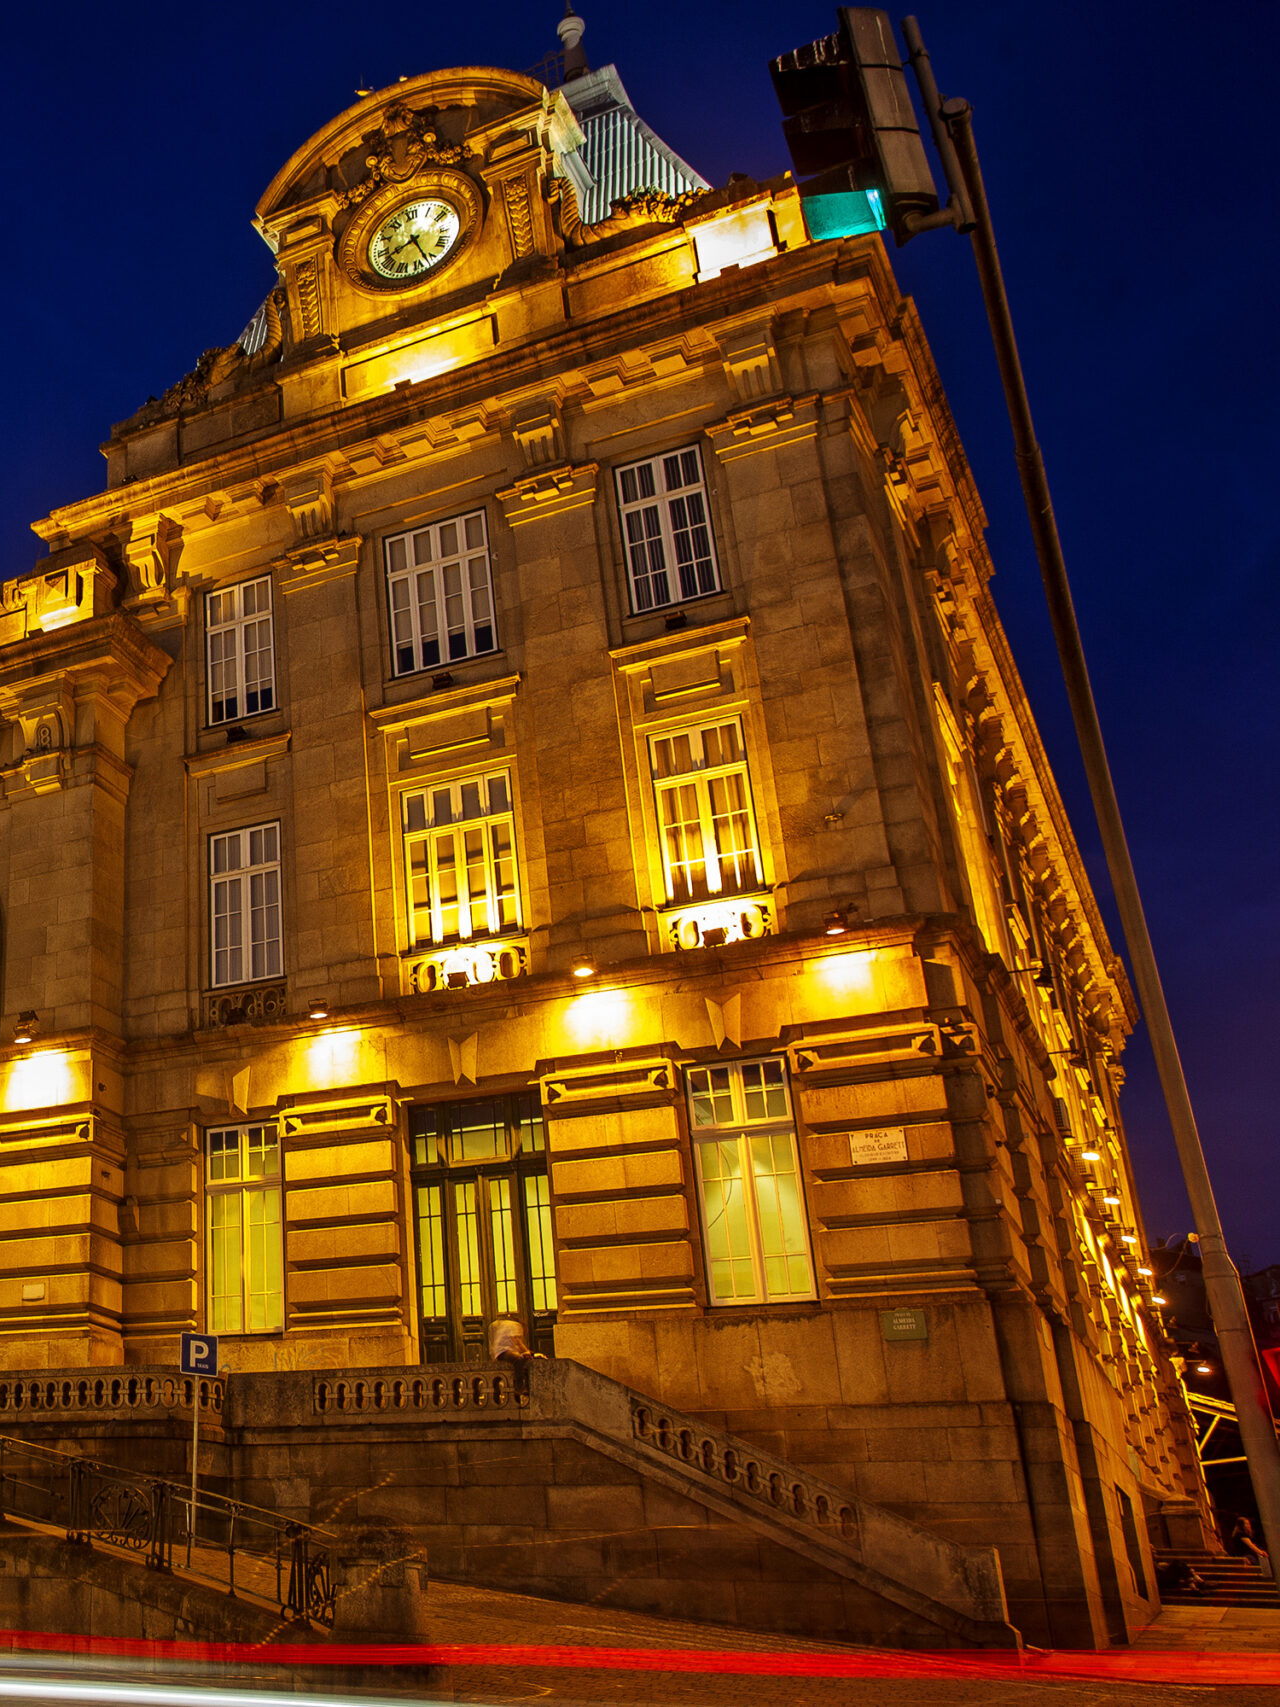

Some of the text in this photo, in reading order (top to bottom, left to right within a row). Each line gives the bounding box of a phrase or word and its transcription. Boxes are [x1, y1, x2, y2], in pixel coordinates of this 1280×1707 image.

[405, 209, 418, 222] XII
[434, 210, 447, 222] II
[389, 220, 402, 232] XI
[396, 262, 408, 274] VII
[190, 1340, 209, 1368] P
